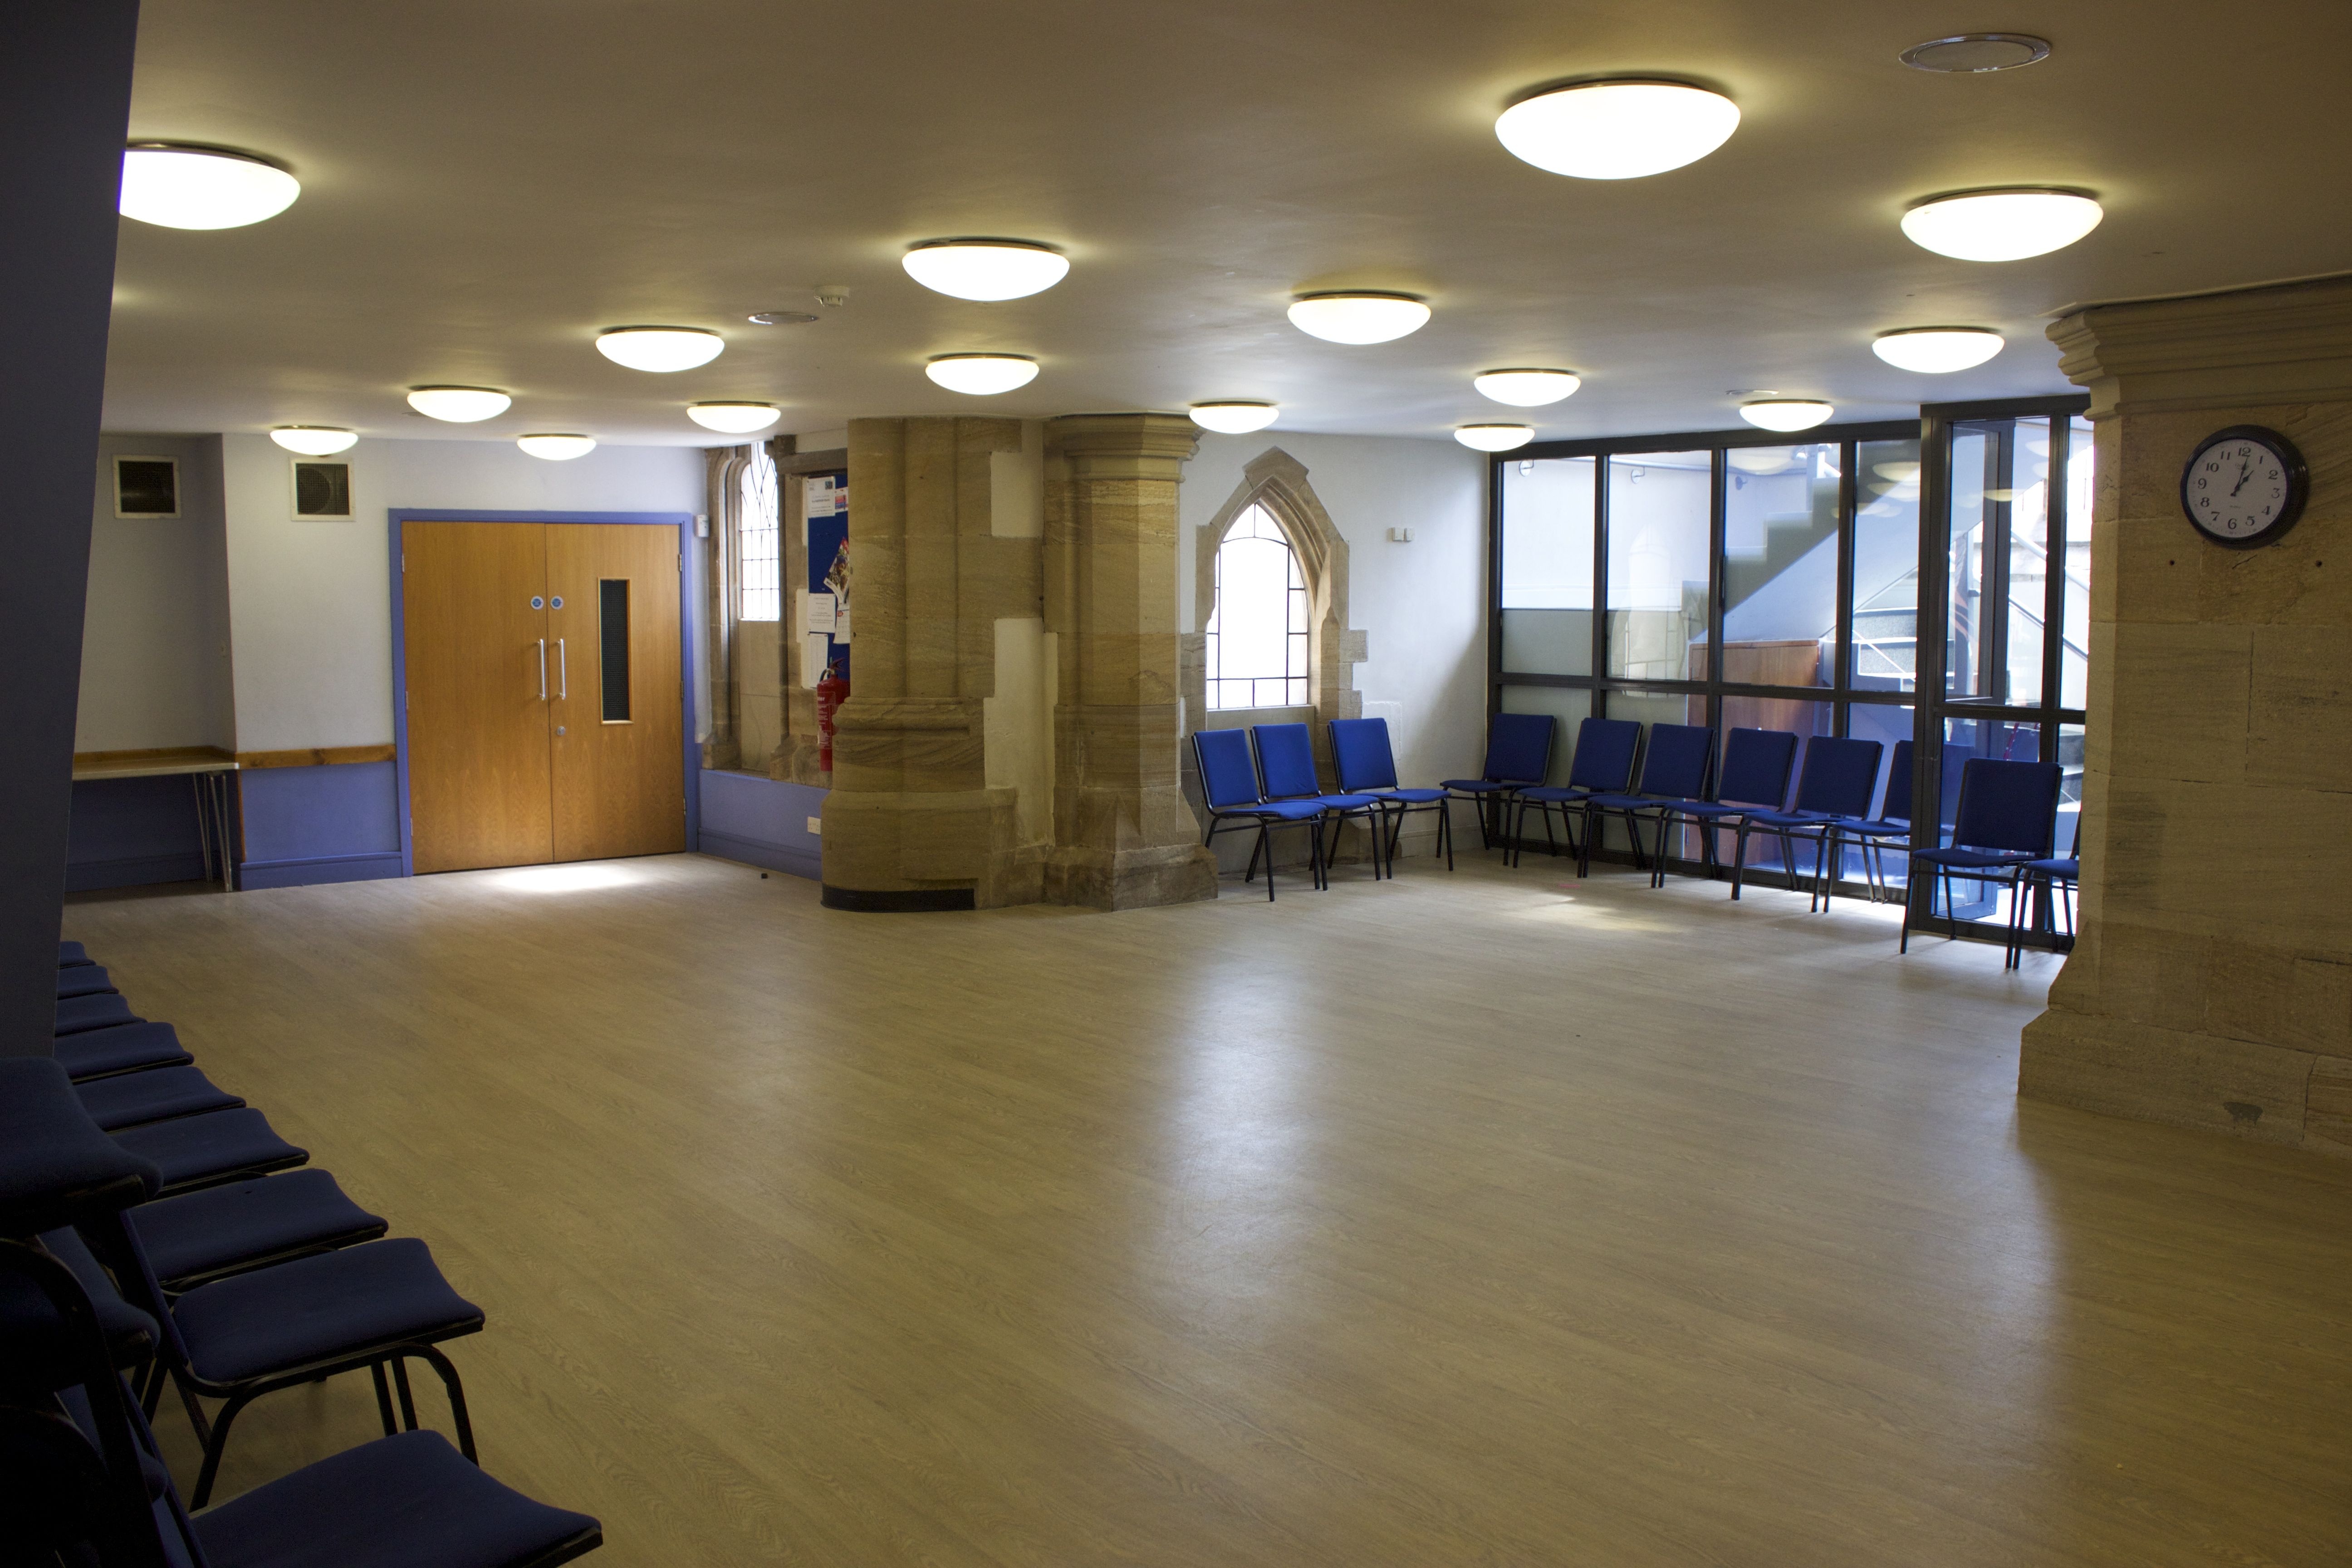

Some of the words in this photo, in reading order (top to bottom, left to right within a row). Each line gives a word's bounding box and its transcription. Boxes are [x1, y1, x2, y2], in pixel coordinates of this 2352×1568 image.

[2220, 451, 2230, 460] 11
[2238, 447, 2251, 457] 12
[2259, 456, 2263, 464] 1
[2206, 462, 2219, 472] 10
[2268, 470, 2278, 480] 2
[2198, 478, 2207, 489] 9
[2271, 488, 2280, 499] 3
[2200, 497, 2210, 507] 8
[2262, 505, 2270, 515] 4
[2211, 511, 2220, 521] 7
[2245, 516, 2255, 526] 5
[2228, 518, 2237, 529] 6
